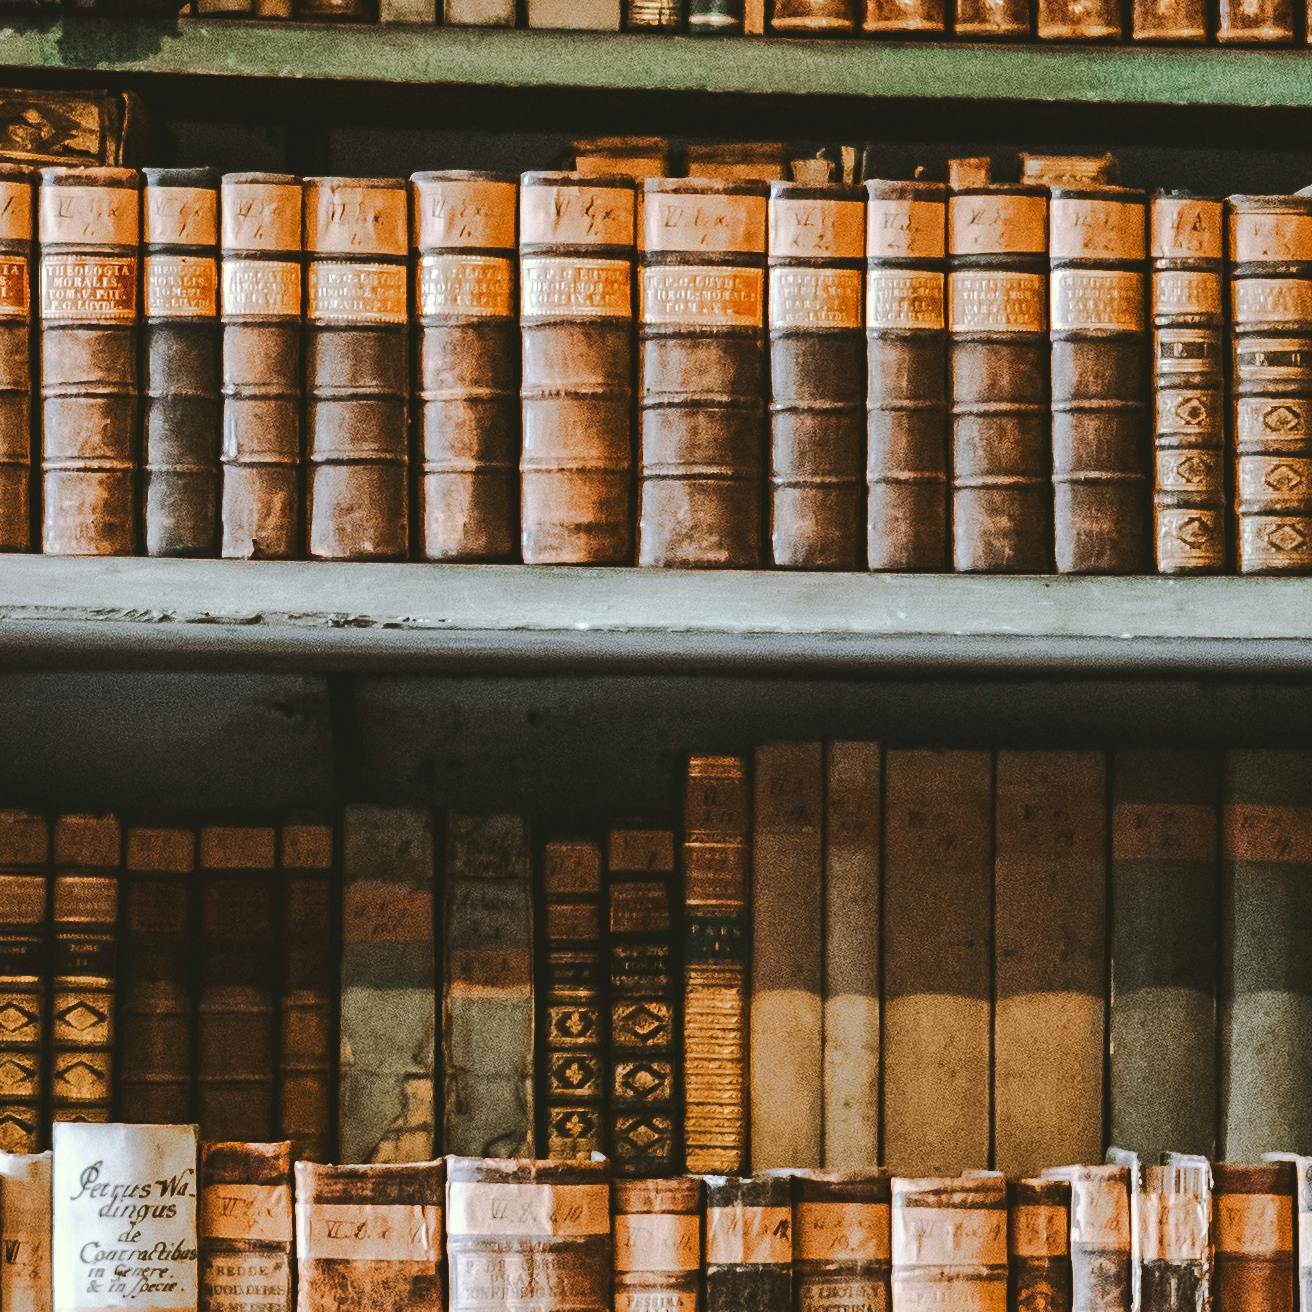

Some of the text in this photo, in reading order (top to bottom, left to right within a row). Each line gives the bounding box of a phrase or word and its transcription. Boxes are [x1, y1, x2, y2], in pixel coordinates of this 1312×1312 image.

[46, 265, 130, 276] THEOLOGIA
[70, 1160, 152, 1201] Petrus
[98, 1196, 177, 1225] dingus
[117, 1220, 142, 1244] de
[79, 1238, 198, 1265] Contractibus
[88, 1266, 106, 1279] in
[86, 1280, 105, 1293] &
